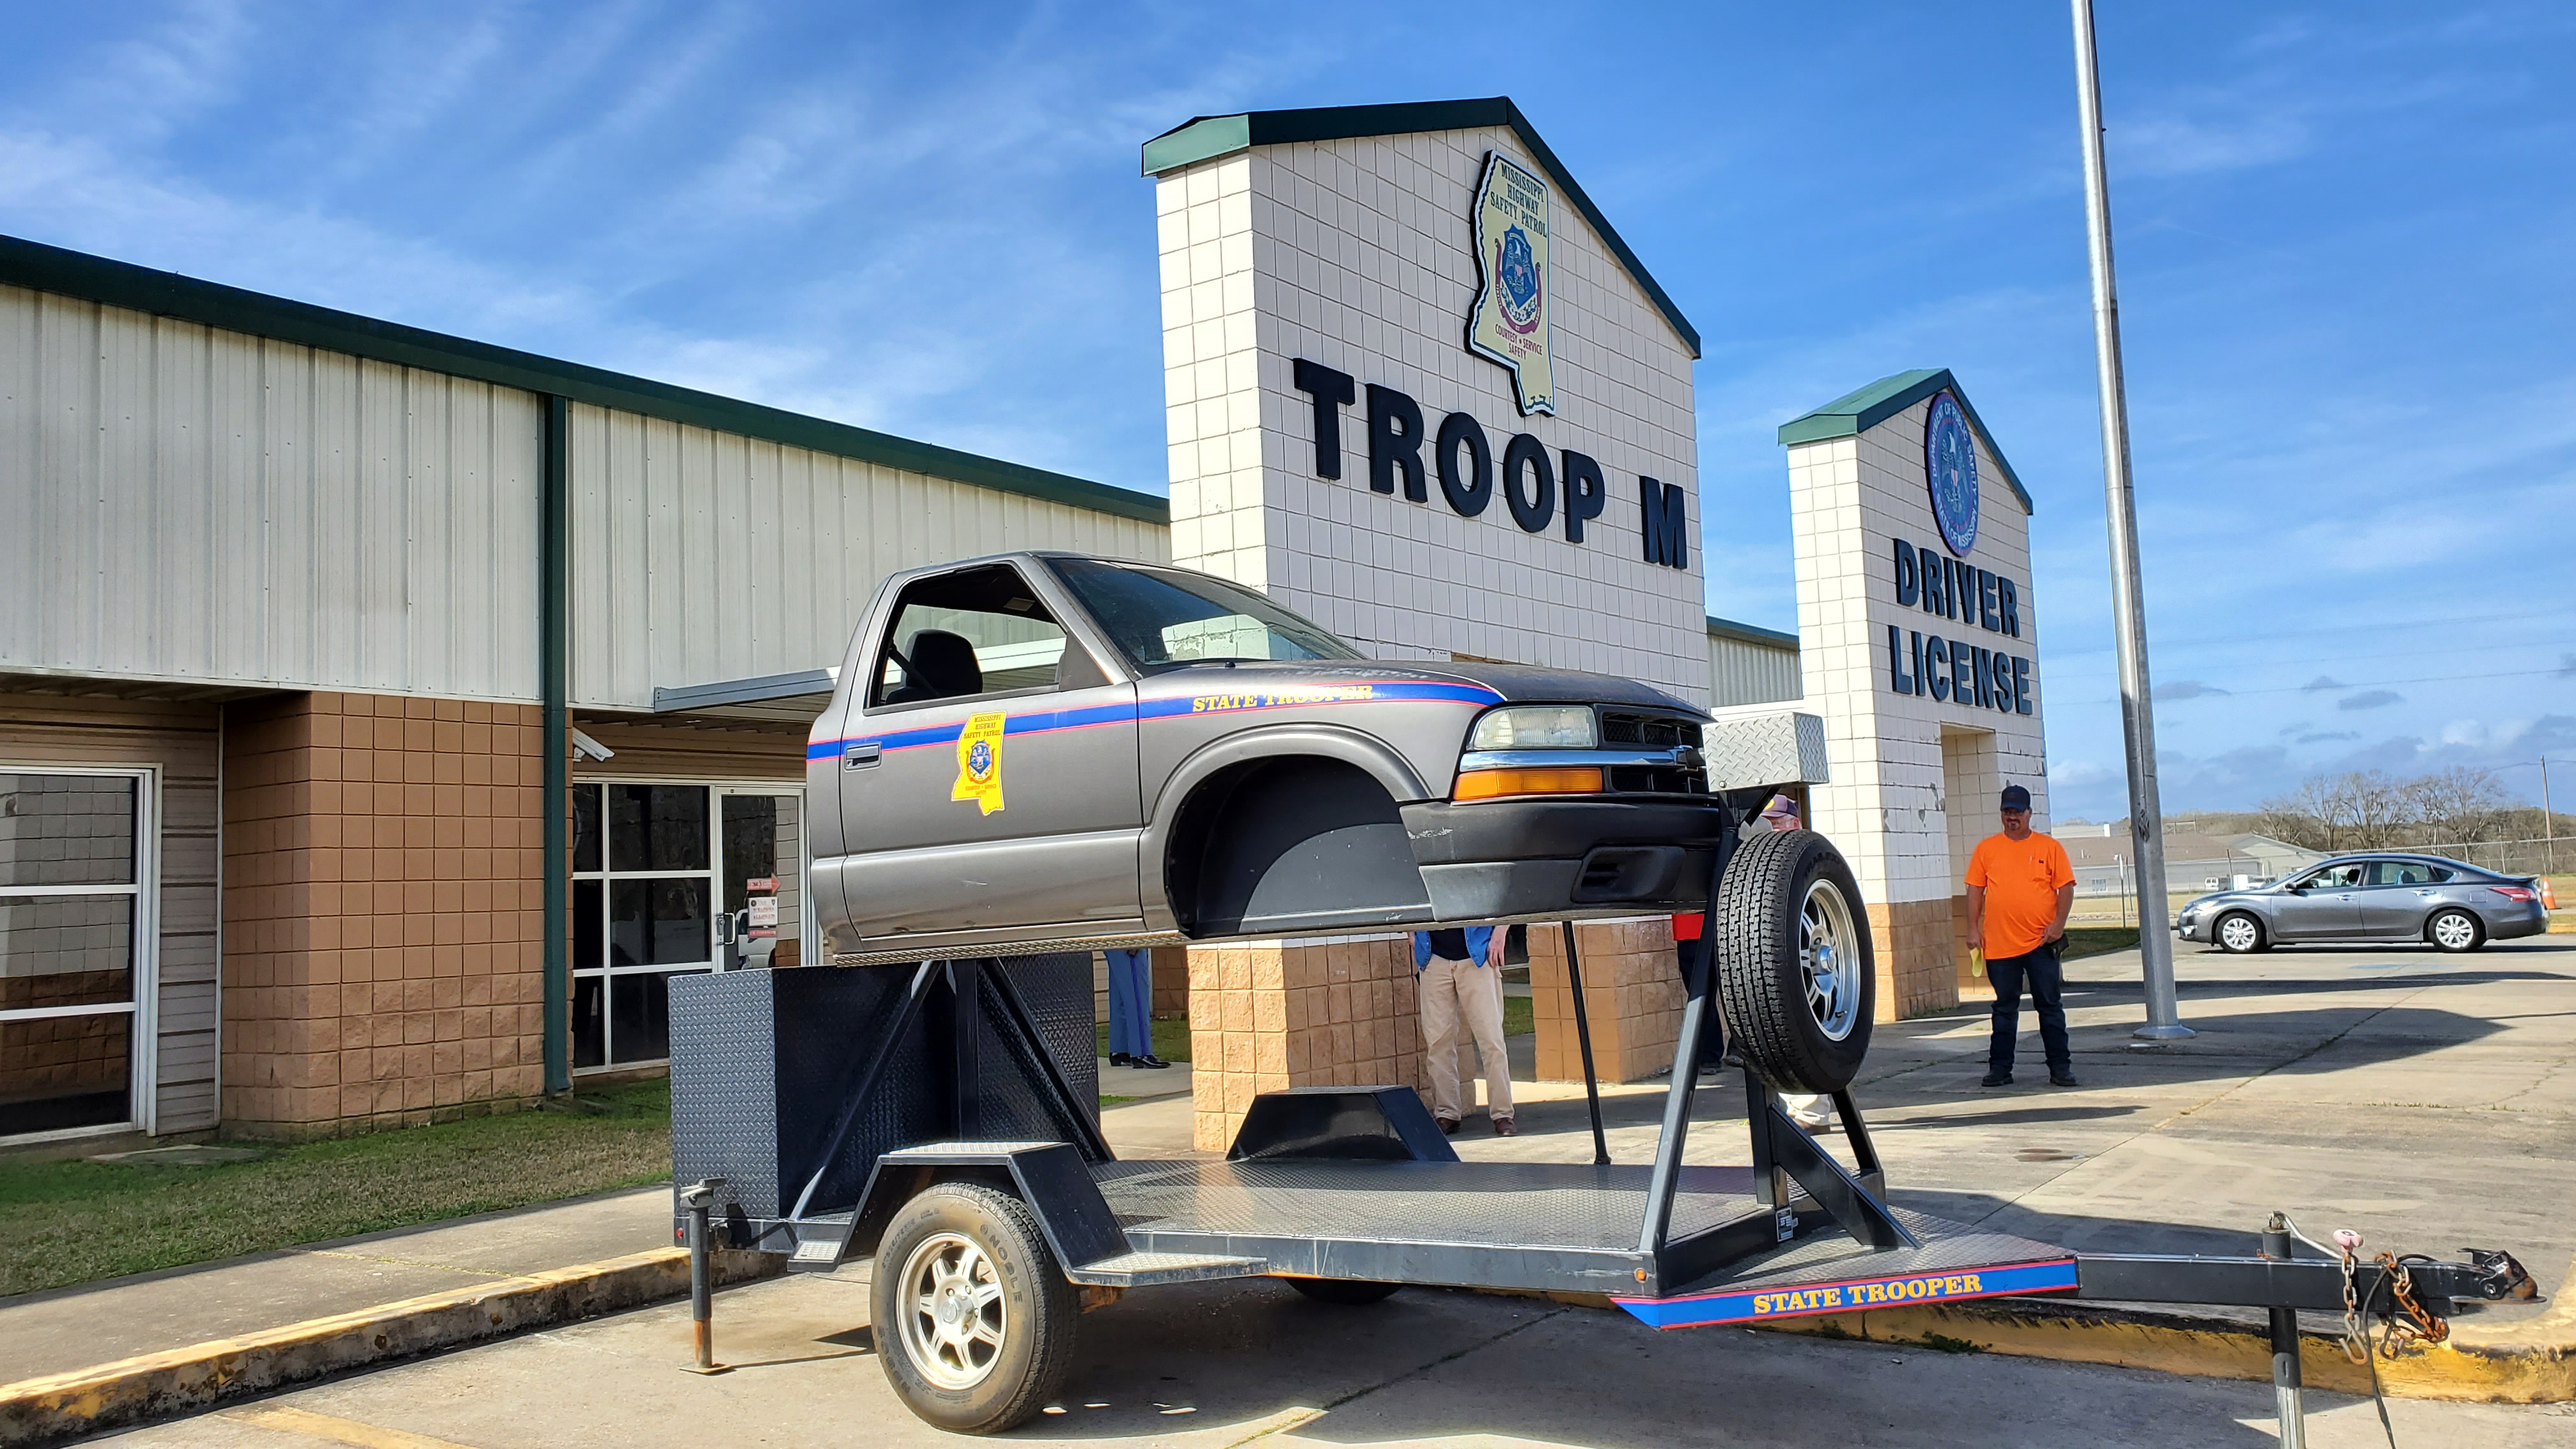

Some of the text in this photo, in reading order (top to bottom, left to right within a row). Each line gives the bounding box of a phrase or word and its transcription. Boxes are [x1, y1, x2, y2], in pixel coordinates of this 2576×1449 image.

[1501, 162, 1544, 203] MISSISSIPPI
[1507, 183, 1538, 215] HIGHWAY
[1490, 191, 1547, 238] SAFETY PATROL
[1495, 323, 1543, 356] COURTESY SERVICE
[1508, 344, 1527, 360] SAFETY
[1293, 357, 1688, 569] TROOP M
[1931, 402, 1977, 497] DEPARTMENT OF PUBLIC SAFETY
[1936, 493, 1950, 533] STATE
[1951, 528, 1957, 542] OF
[1892, 538, 2020, 638] DRIVER
[1888, 625, 2032, 715] LICENSE
[974, 714, 1001, 723] MISSISSIPPI
[1193, 686, 1373, 712] STATE TROOPER
[989, 1234, 1022, 1303] NOBLE
[1753, 1275, 1982, 1314] STATE TROOPER
